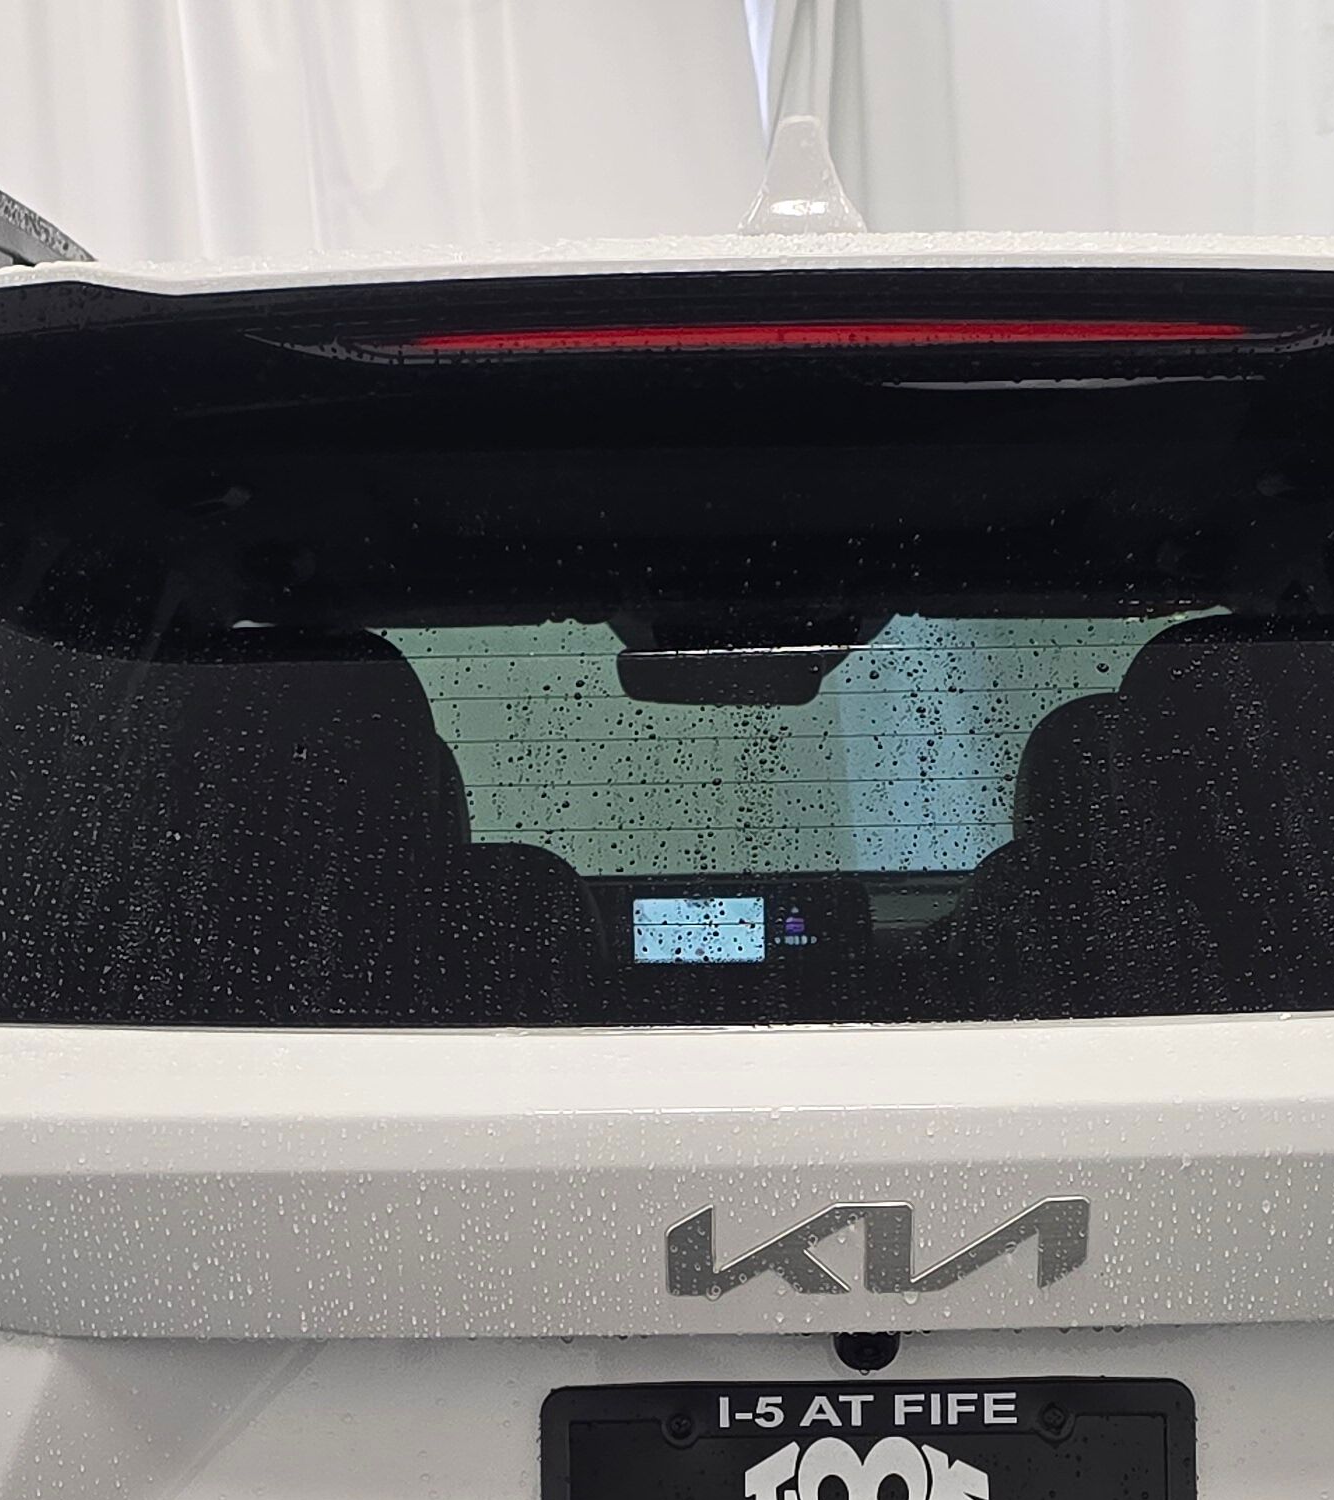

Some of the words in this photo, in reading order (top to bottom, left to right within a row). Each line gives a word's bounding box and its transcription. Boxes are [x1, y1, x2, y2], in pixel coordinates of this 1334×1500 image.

[719, 1396, 785, 1428] I-5
[799, 1394, 875, 1427] AT
[894, 1392, 1018, 1426] FIFE
